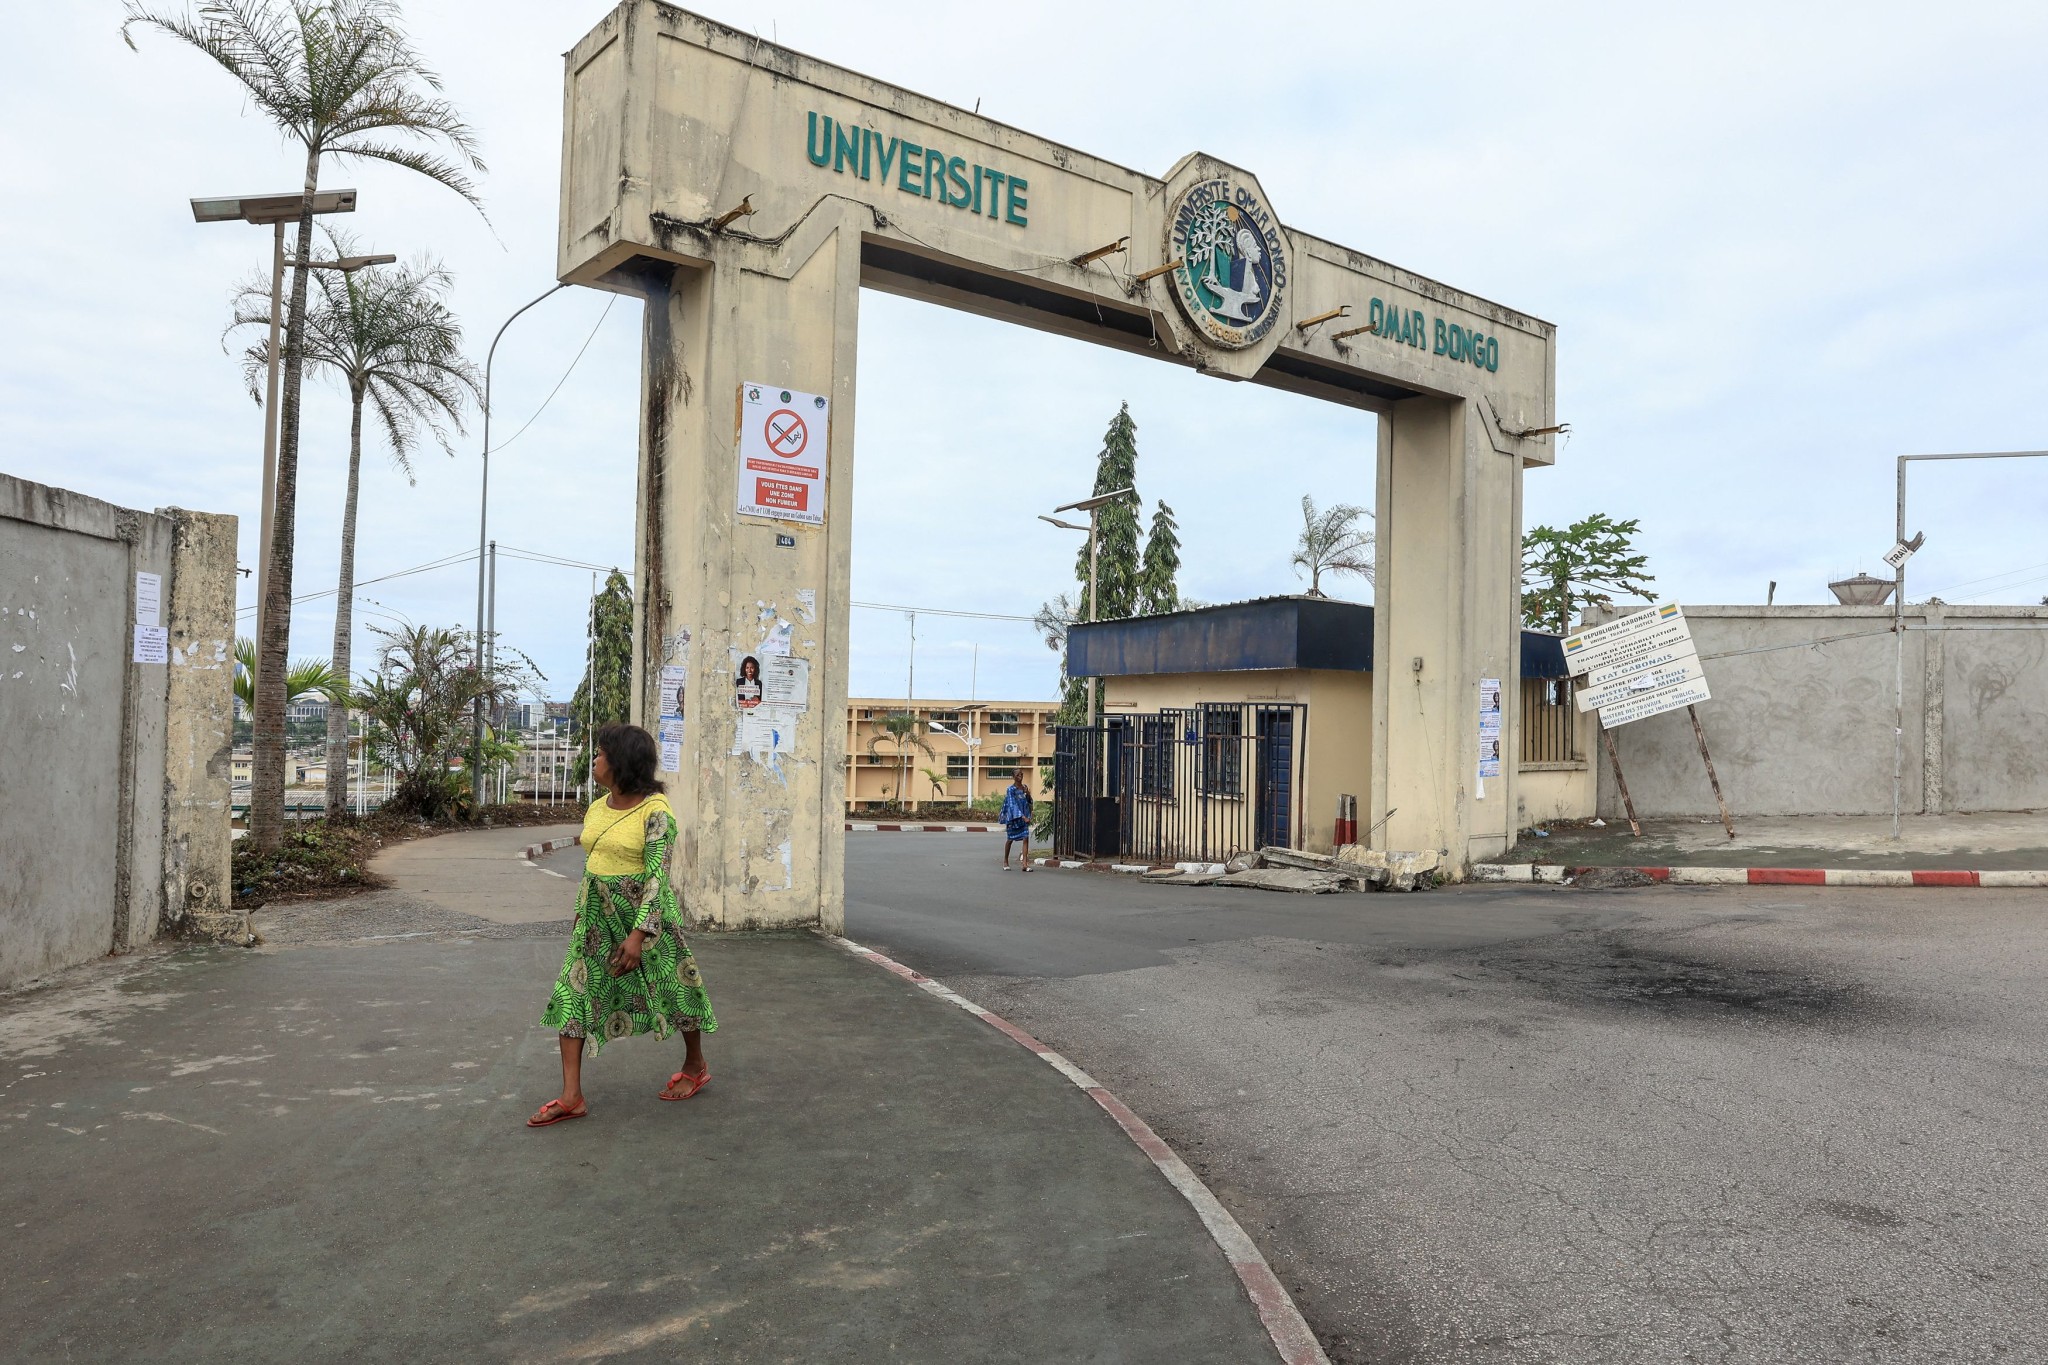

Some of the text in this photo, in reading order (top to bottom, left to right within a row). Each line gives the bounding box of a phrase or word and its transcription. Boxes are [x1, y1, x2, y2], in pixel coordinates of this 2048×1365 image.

[808, 110, 1028, 226] UNIVERSITE
[1173, 180, 1286, 289] UNIVERSITE OMAR BONGO
[1370, 297, 1498, 373] OMAR BONGO
[778, 499, 798, 507] FUMEUR
[1890, 546, 1908, 563] TRAV
[1584, 610, 1656, 640] REPUBLIQUE GABONAISE
[1590, 620, 1653, 644] UNION TRAVAIL JUSTICE
[1577, 651, 1607, 663] TRAVAUX
[1620, 627, 1677, 649] REHABILITATION
[1588, 653, 1633, 670] L'UNIVERSITE
[1635, 645, 1656, 655] OMAR
[1659, 635, 1684, 646] BONGO
[1614, 643, 1647, 656] PAVILLON
[1596, 654, 1672, 682] ETAT GABONAIS
[1612, 655, 1648, 670] FINANCEMENT
[1603, 681, 1626, 690] MAITRE
[1653, 669, 1689, 681] ETROLE,
[1606, 688, 1678, 712] MAITRE D'OUVRAGE DELEGUE
[1607, 694, 1624, 702] GAZ
[1657, 675, 1686, 687] MINES
[1637, 700, 1661, 711] TRAVAUX
[1656, 693, 1706, 712] INFRASTRUCTURES
